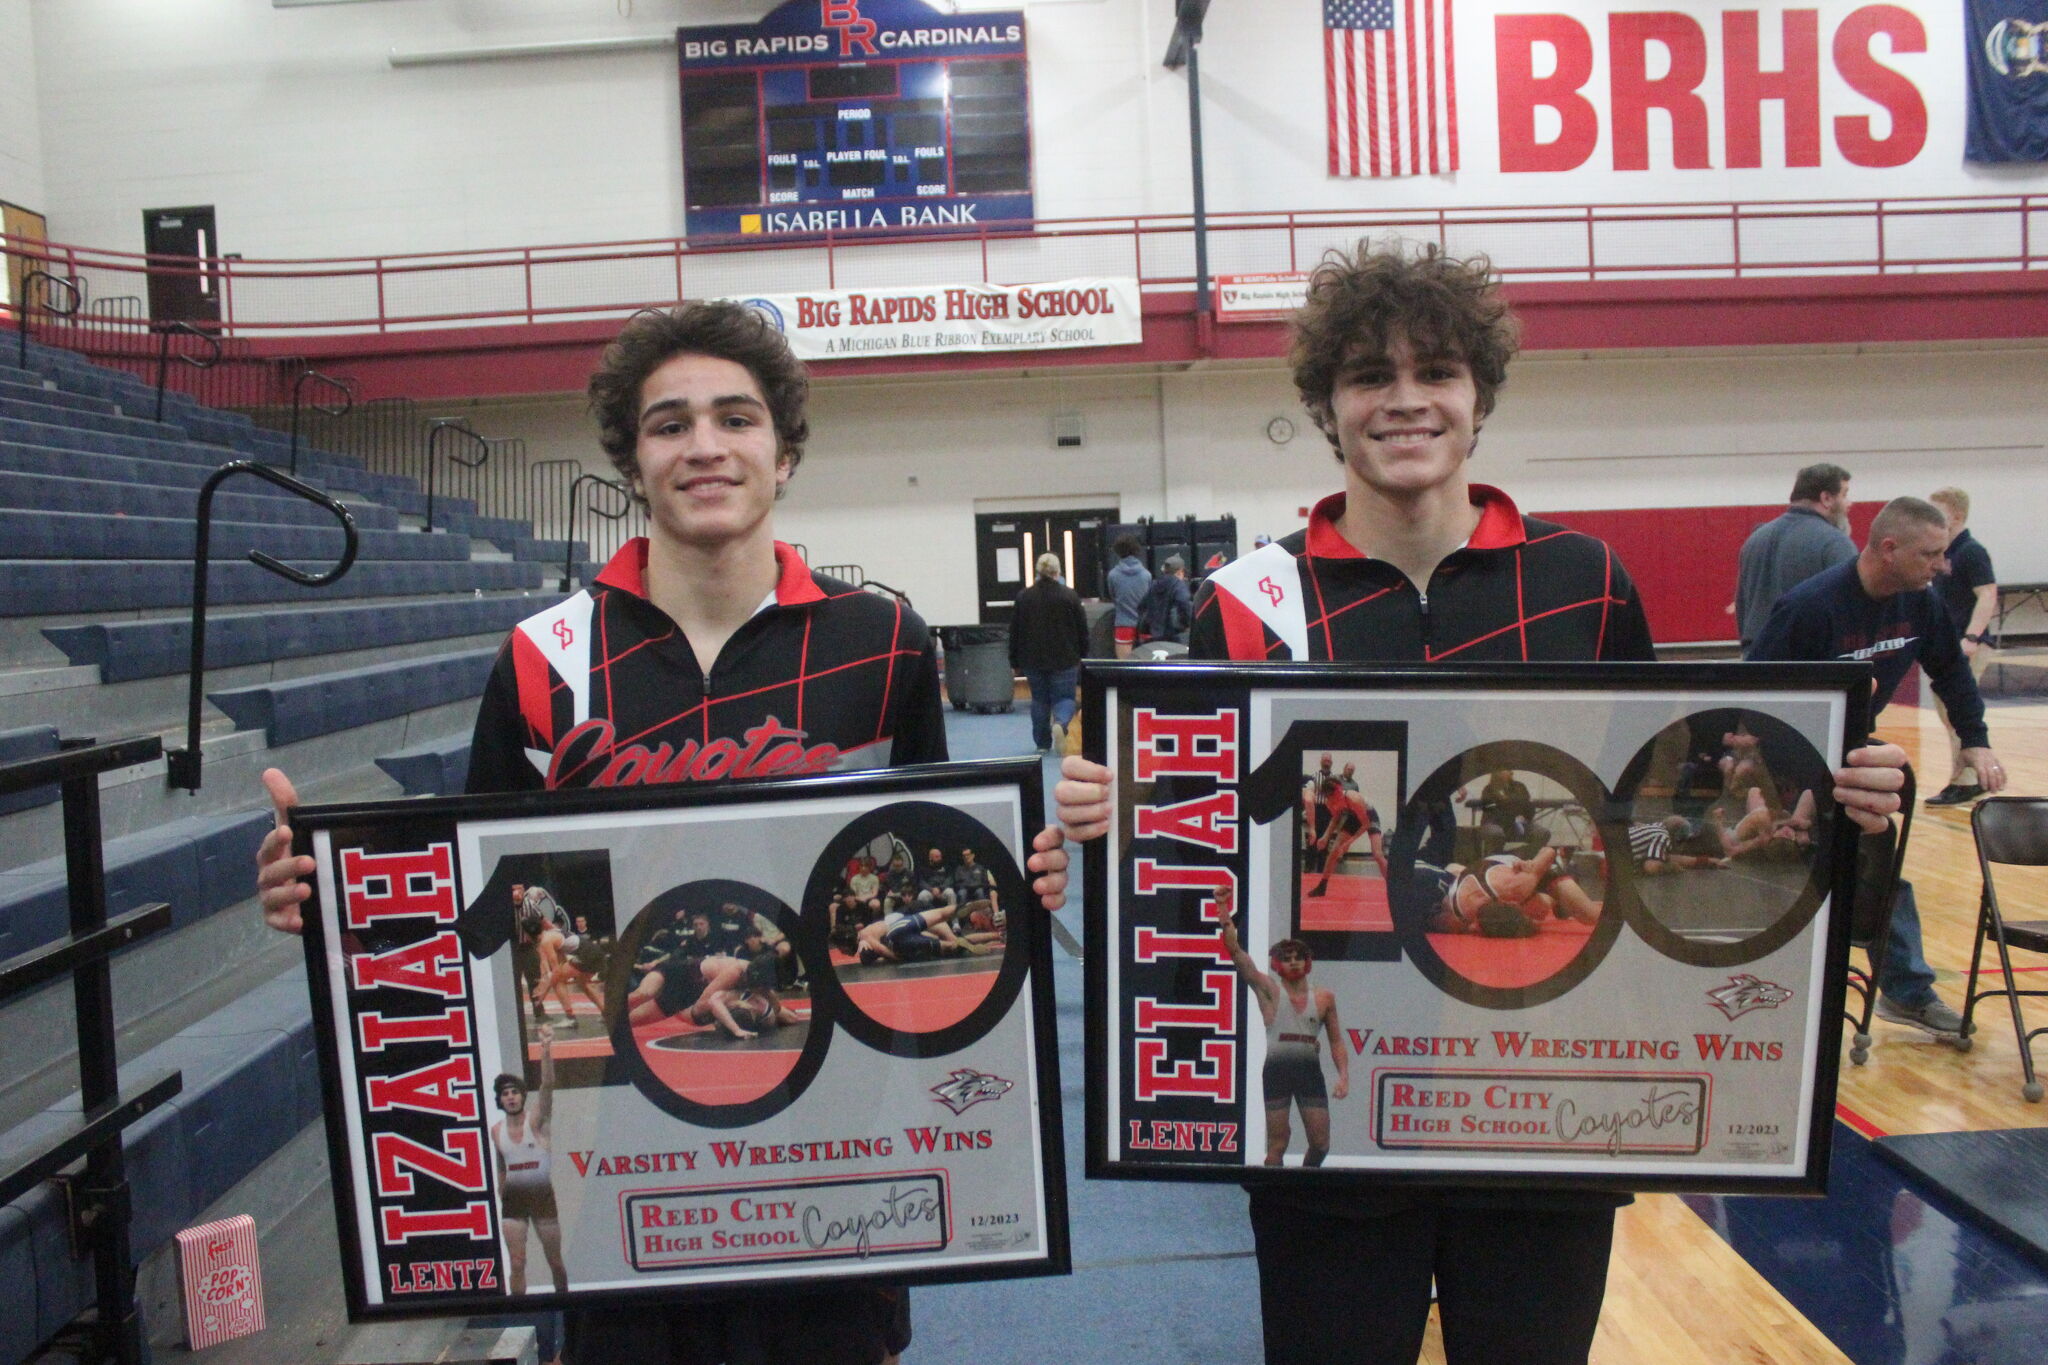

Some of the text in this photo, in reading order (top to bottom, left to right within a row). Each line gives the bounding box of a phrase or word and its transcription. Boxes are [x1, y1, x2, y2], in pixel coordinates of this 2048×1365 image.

[685, 35, 829, 59] BIG RAPIDS
[880, 25, 1021, 47] CARDINALS
[1494, 3, 1928, 173] BRHS
[838, 108, 872, 120] PERIOD
[768, 154, 797, 166] FOULS
[827, 149, 887, 162] PLAYER FOUL
[915, 146, 945, 158] FOULS
[769, 191, 799, 203] SCORE
[842, 188, 875, 199] MATCH
[916, 184, 947, 196] SCORE
[901, 203, 978, 227] BANK
[796, 297, 841, 328] BIG
[848, 293, 937, 326] RAPIDS
[944, 288, 1010, 321] HIGH
[1017, 287, 1115, 319] SCHOOL
[825, 327, 1096, 352] A MICHIGAN BLUE RIBBON EXEMPLARY SCHOOL
[1133, 708, 1239, 1103] ELIJAH
[340, 842, 493, 1245] IZAIAH
[1346, 1029, 1784, 1062] VARSITY WRESTLING WINS
[1390, 1083, 1554, 1110] REED CITY
[1390, 1114, 1552, 1136] HIGH SCHOOL
[1555, 1085, 1699, 1157] Coyotes
[1728, 1124, 1780, 1135] 12/2023
[1130, 1120, 1238, 1152] LENTZ
[568, 1126, 993, 1178] VARSITY WRESTLING WINS
[640, 1197, 798, 1229] REED CITY
[801, 1184, 941, 1260] Coyotes
[971, 1213, 1020, 1227] 12/2023
[643, 1228, 800, 1254] HIGH SCHOOL
[211, 1268, 239, 1287] POP
[389, 1257, 497, 1294] LENTZ
[207, 1278, 245, 1301] CORN
